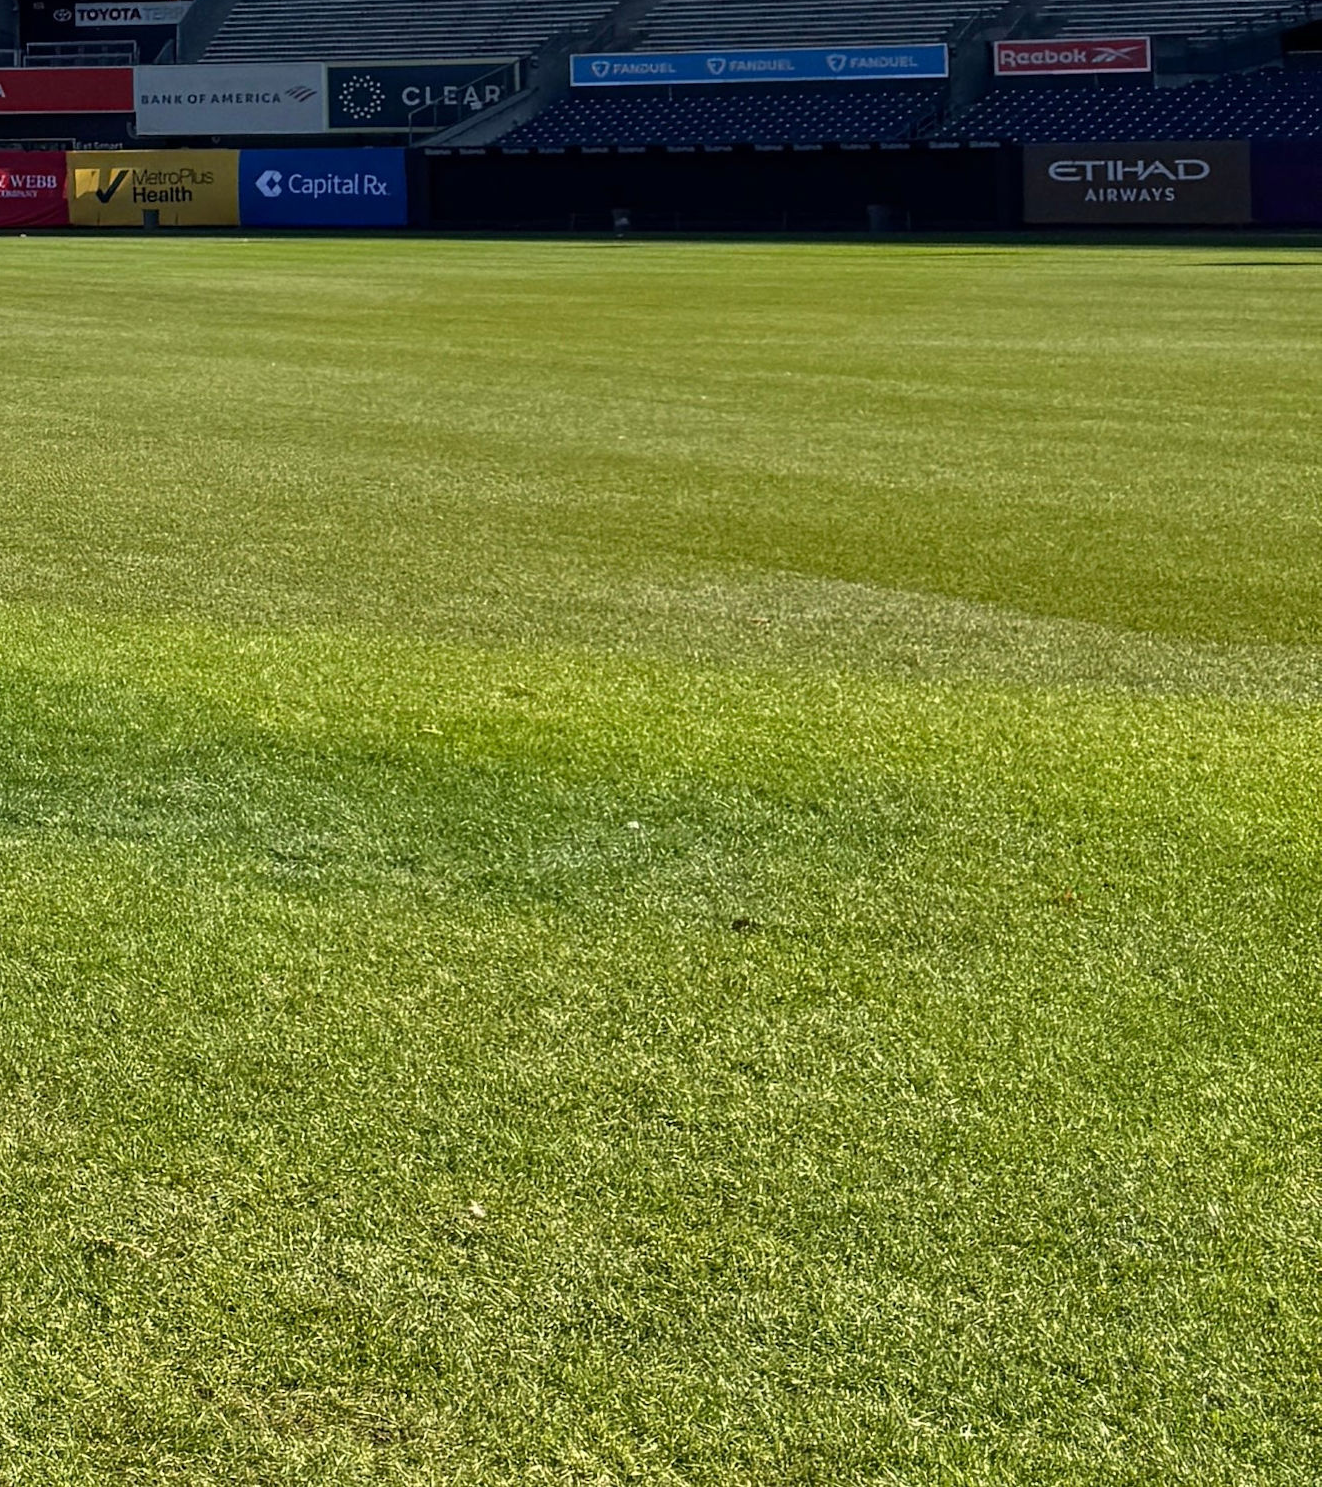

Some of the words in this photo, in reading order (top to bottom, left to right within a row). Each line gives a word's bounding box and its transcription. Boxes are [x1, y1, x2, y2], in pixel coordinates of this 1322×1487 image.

[77, 8, 142, 21] TOYOTA
[999, 48, 1087, 67] Reebok
[140, 94, 182, 106] BANK
[188, 93, 208, 105] OF
[210, 91, 281, 105] AMERICA
[401, 84, 501, 107] CLEAR
[132, 169, 214, 186] MetroPlus
[1047, 159, 1211, 181] ETIHAD
[10, 174, 57, 189] WEBB
[288, 173, 360, 199] Capital
[363, 175, 388, 196] Rx
[133, 185, 193, 203] Health
[1084, 187, 1176, 202] AIRWAYS
